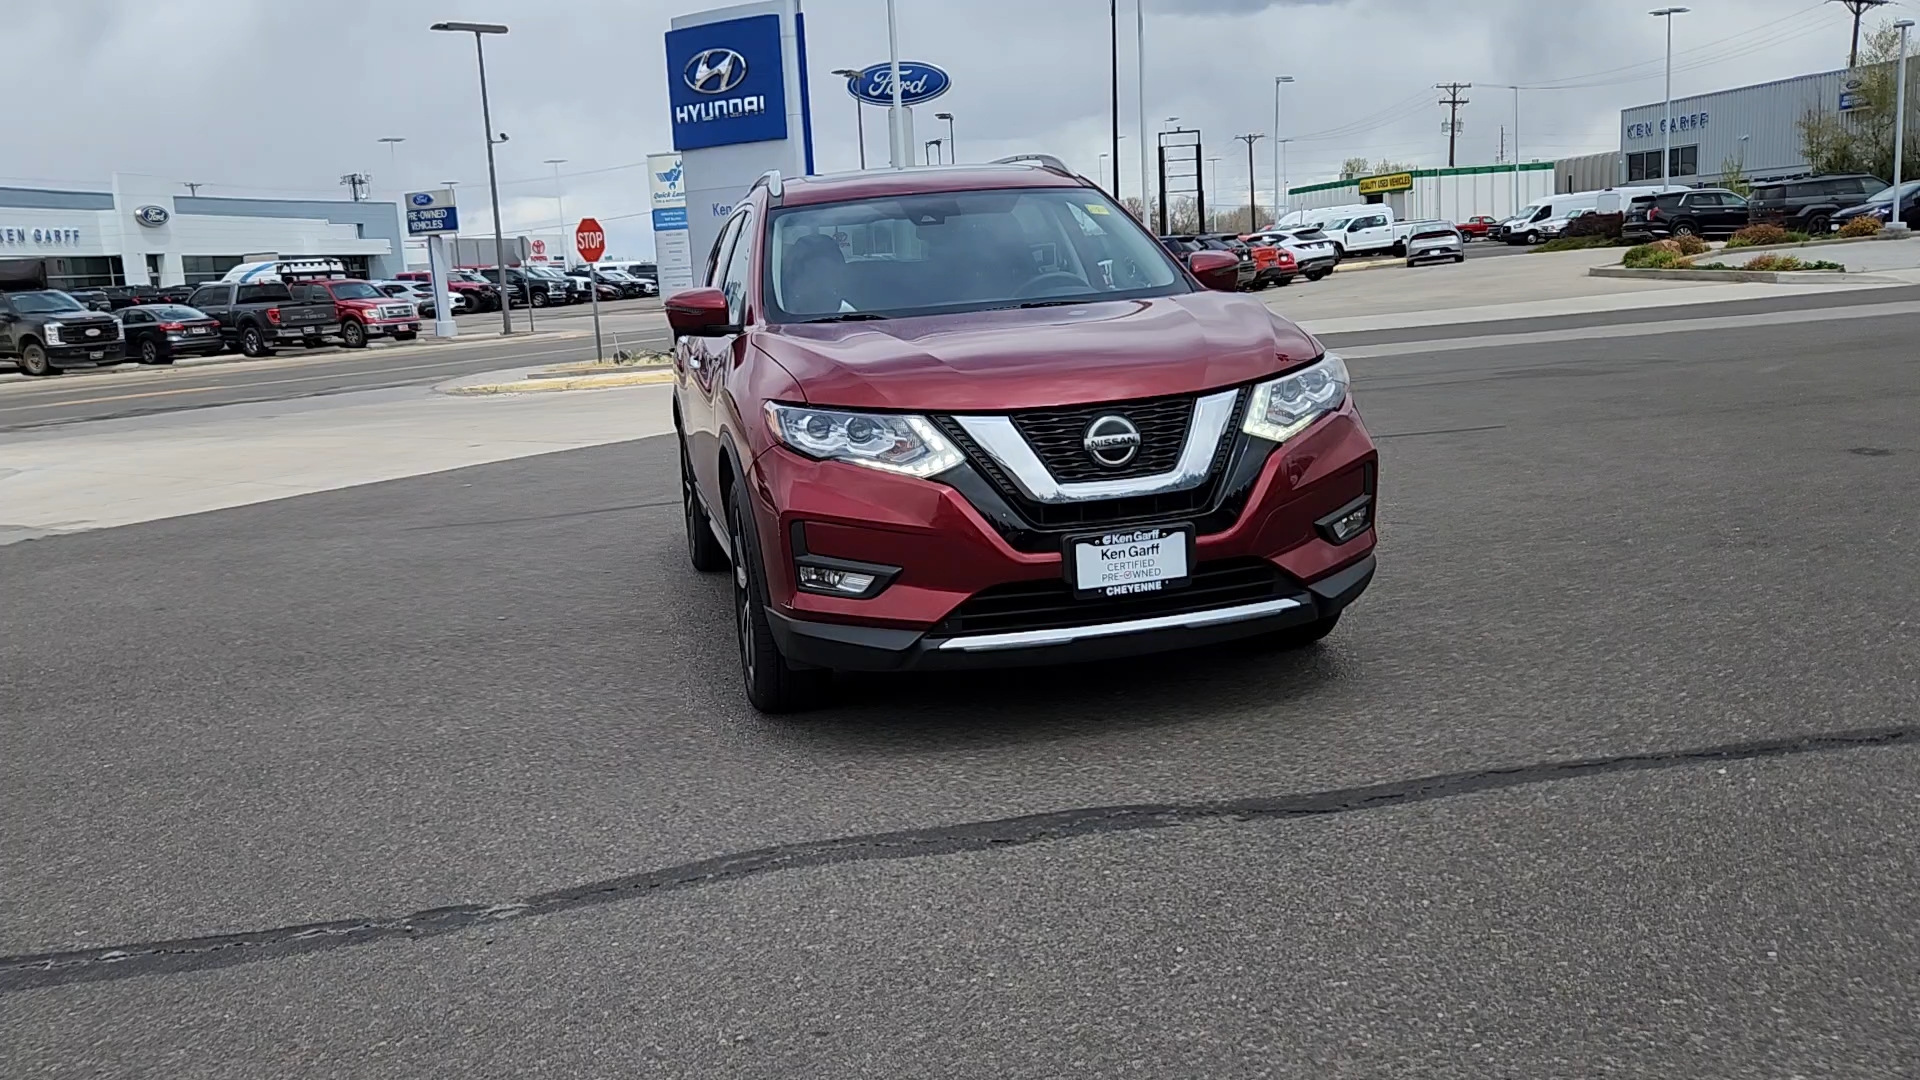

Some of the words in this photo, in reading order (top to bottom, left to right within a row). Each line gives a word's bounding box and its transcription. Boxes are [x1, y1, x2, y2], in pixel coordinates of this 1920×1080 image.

[675, 95, 765, 124] HYUNDAI
[1627, 121, 1653, 139] KEN
[712, 202, 732, 217] Ken
[410, 219, 444, 231] VEHICLES
[33, 228, 80, 242] GARFF
[577, 231, 603, 250] STOP
[1091, 435, 1136, 448] NISSAN
[1111, 532, 1133, 545] Ken
[1133, 529, 1160, 541] Garff
[1101, 548, 1126, 561] Ken
[1128, 543, 1160, 558] Garff
[1106, 558, 1156, 572] CERTIFIED
[1105, 580, 1163, 596] CHEYENNE
